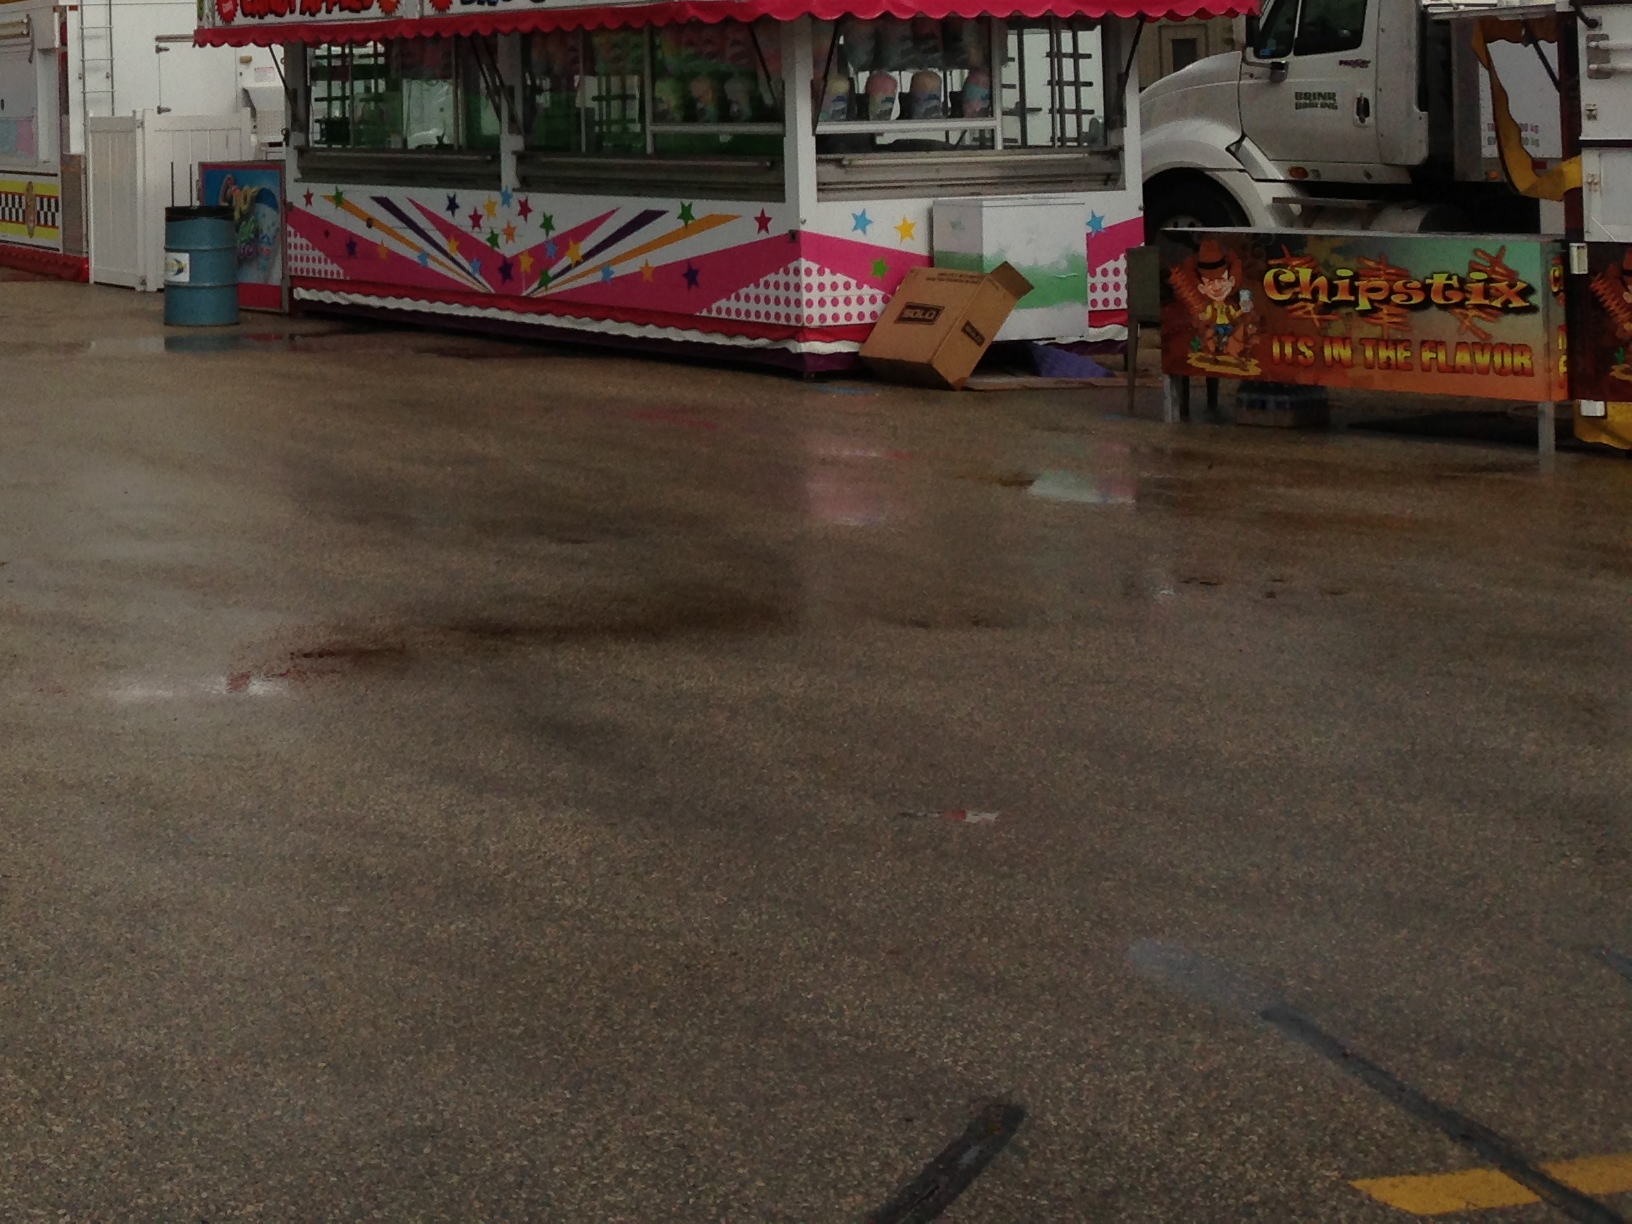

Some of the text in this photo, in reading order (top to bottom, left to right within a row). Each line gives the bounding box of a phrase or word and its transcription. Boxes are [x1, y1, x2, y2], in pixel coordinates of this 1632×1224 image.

[1263, 267, 1534, 312] Chipstix
[1271, 335, 1315, 367] ITS
[1323, 336, 1354, 369] IN
[1359, 337, 1413, 372] THE
[1420, 339, 1535, 377] FLAVOR
